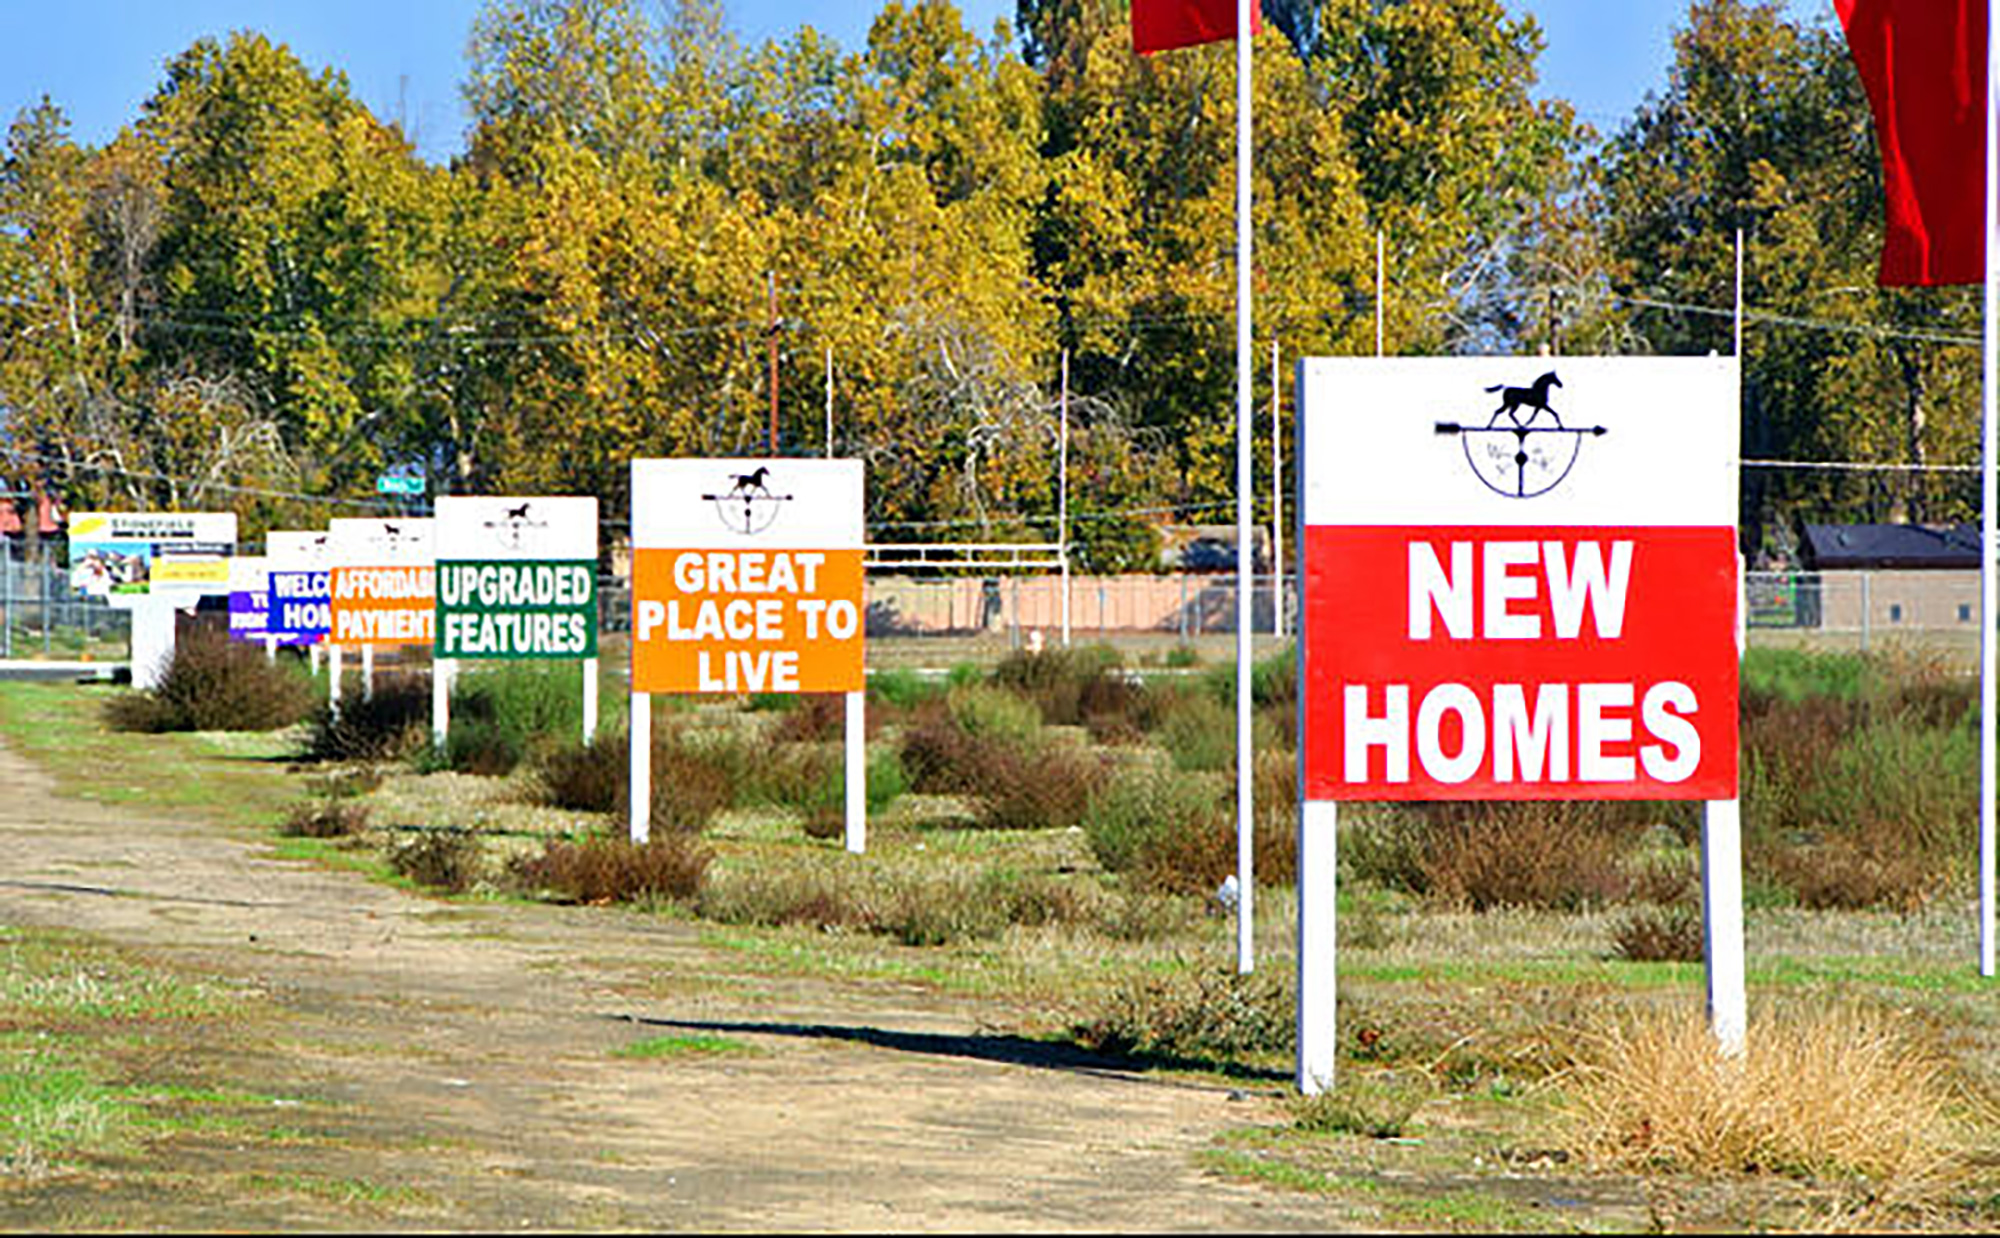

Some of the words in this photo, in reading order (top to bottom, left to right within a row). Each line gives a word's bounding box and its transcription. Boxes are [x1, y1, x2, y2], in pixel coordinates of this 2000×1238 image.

[440, 565, 591, 605] UPGRADED
[674, 552, 825, 593] GREAT
[1408, 540, 1634, 640] NEW
[445, 612, 587, 653] FEATURES
[637, 599, 784, 641] PLACE
[796, 599, 858, 640] TO
[698, 650, 800, 692] LIVE
[1344, 681, 1701, 784] HOMES
